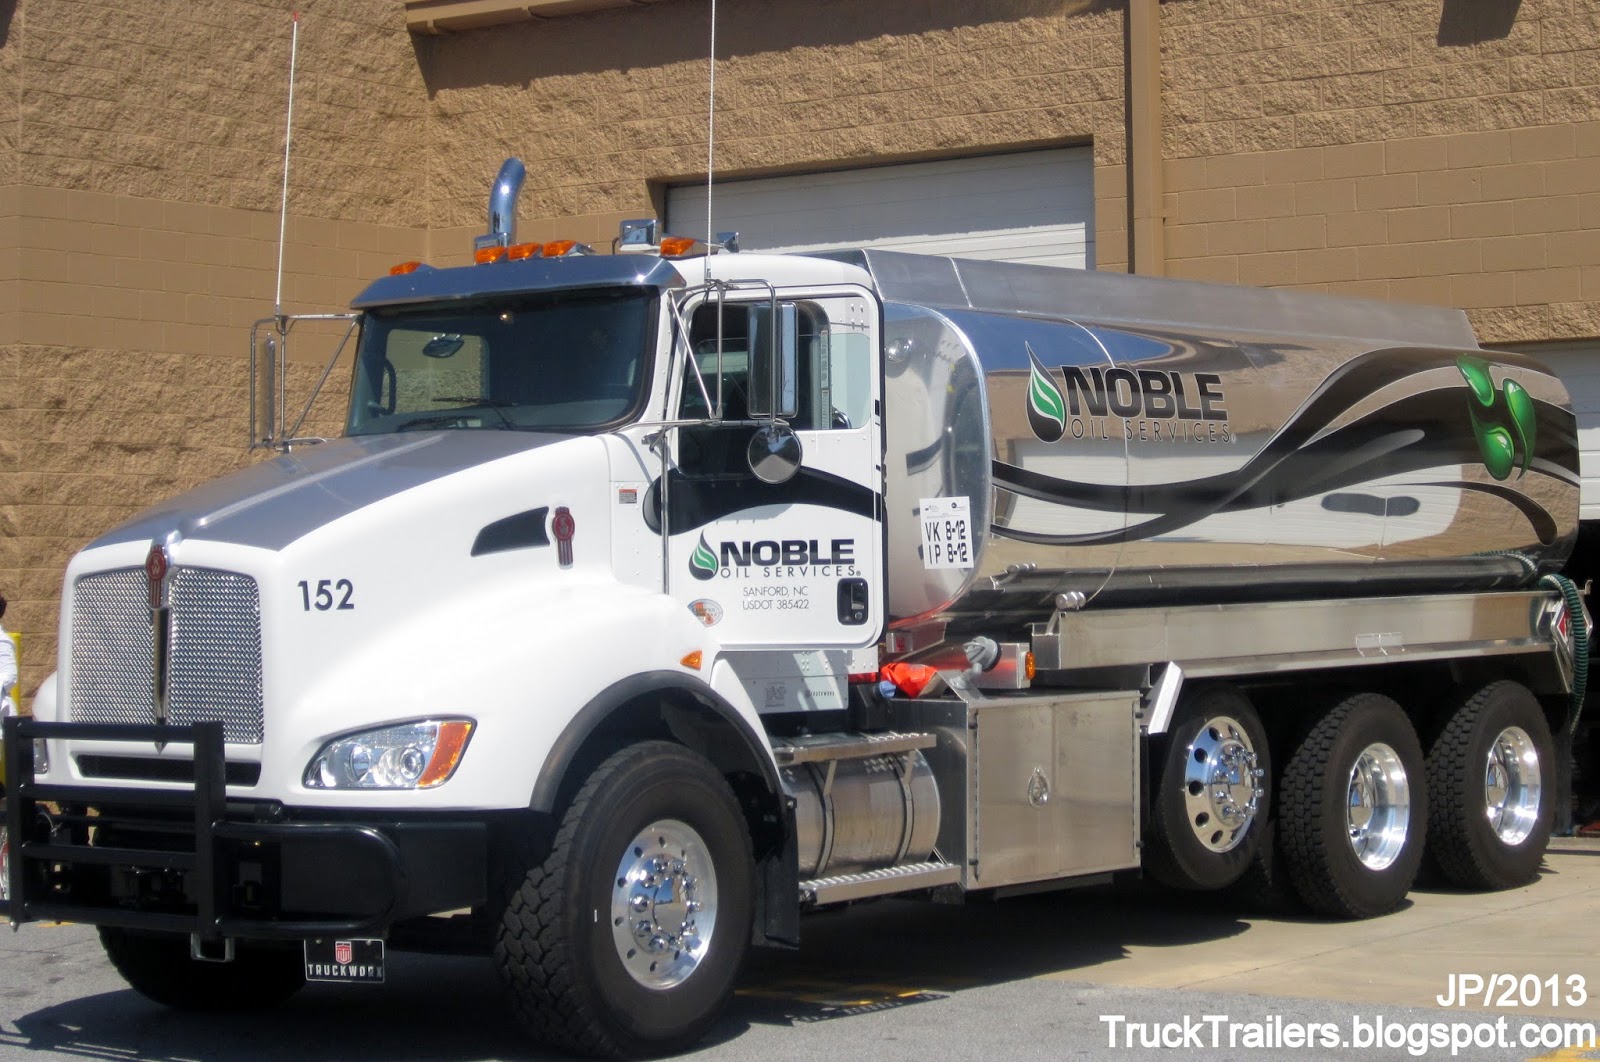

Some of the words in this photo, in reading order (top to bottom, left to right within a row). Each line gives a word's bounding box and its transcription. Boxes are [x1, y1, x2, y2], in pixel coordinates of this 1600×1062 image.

[1060, 365, 1228, 421] NOBLE
[1071, 418, 1108, 440] OIL
[925, 521, 941, 542] VK
[945, 520, 966, 541] 8-12
[720, 539, 855, 567] NOBLE
[947, 542, 968, 563] 8-12
[720, 567, 750, 579] OIL
[297, 578, 355, 611] 152
[742, 586, 789, 597] SANFORD,
[794, 585, 809, 597] NC
[742, 599, 774, 610] USDOT
[776, 598, 810, 610] 385422
